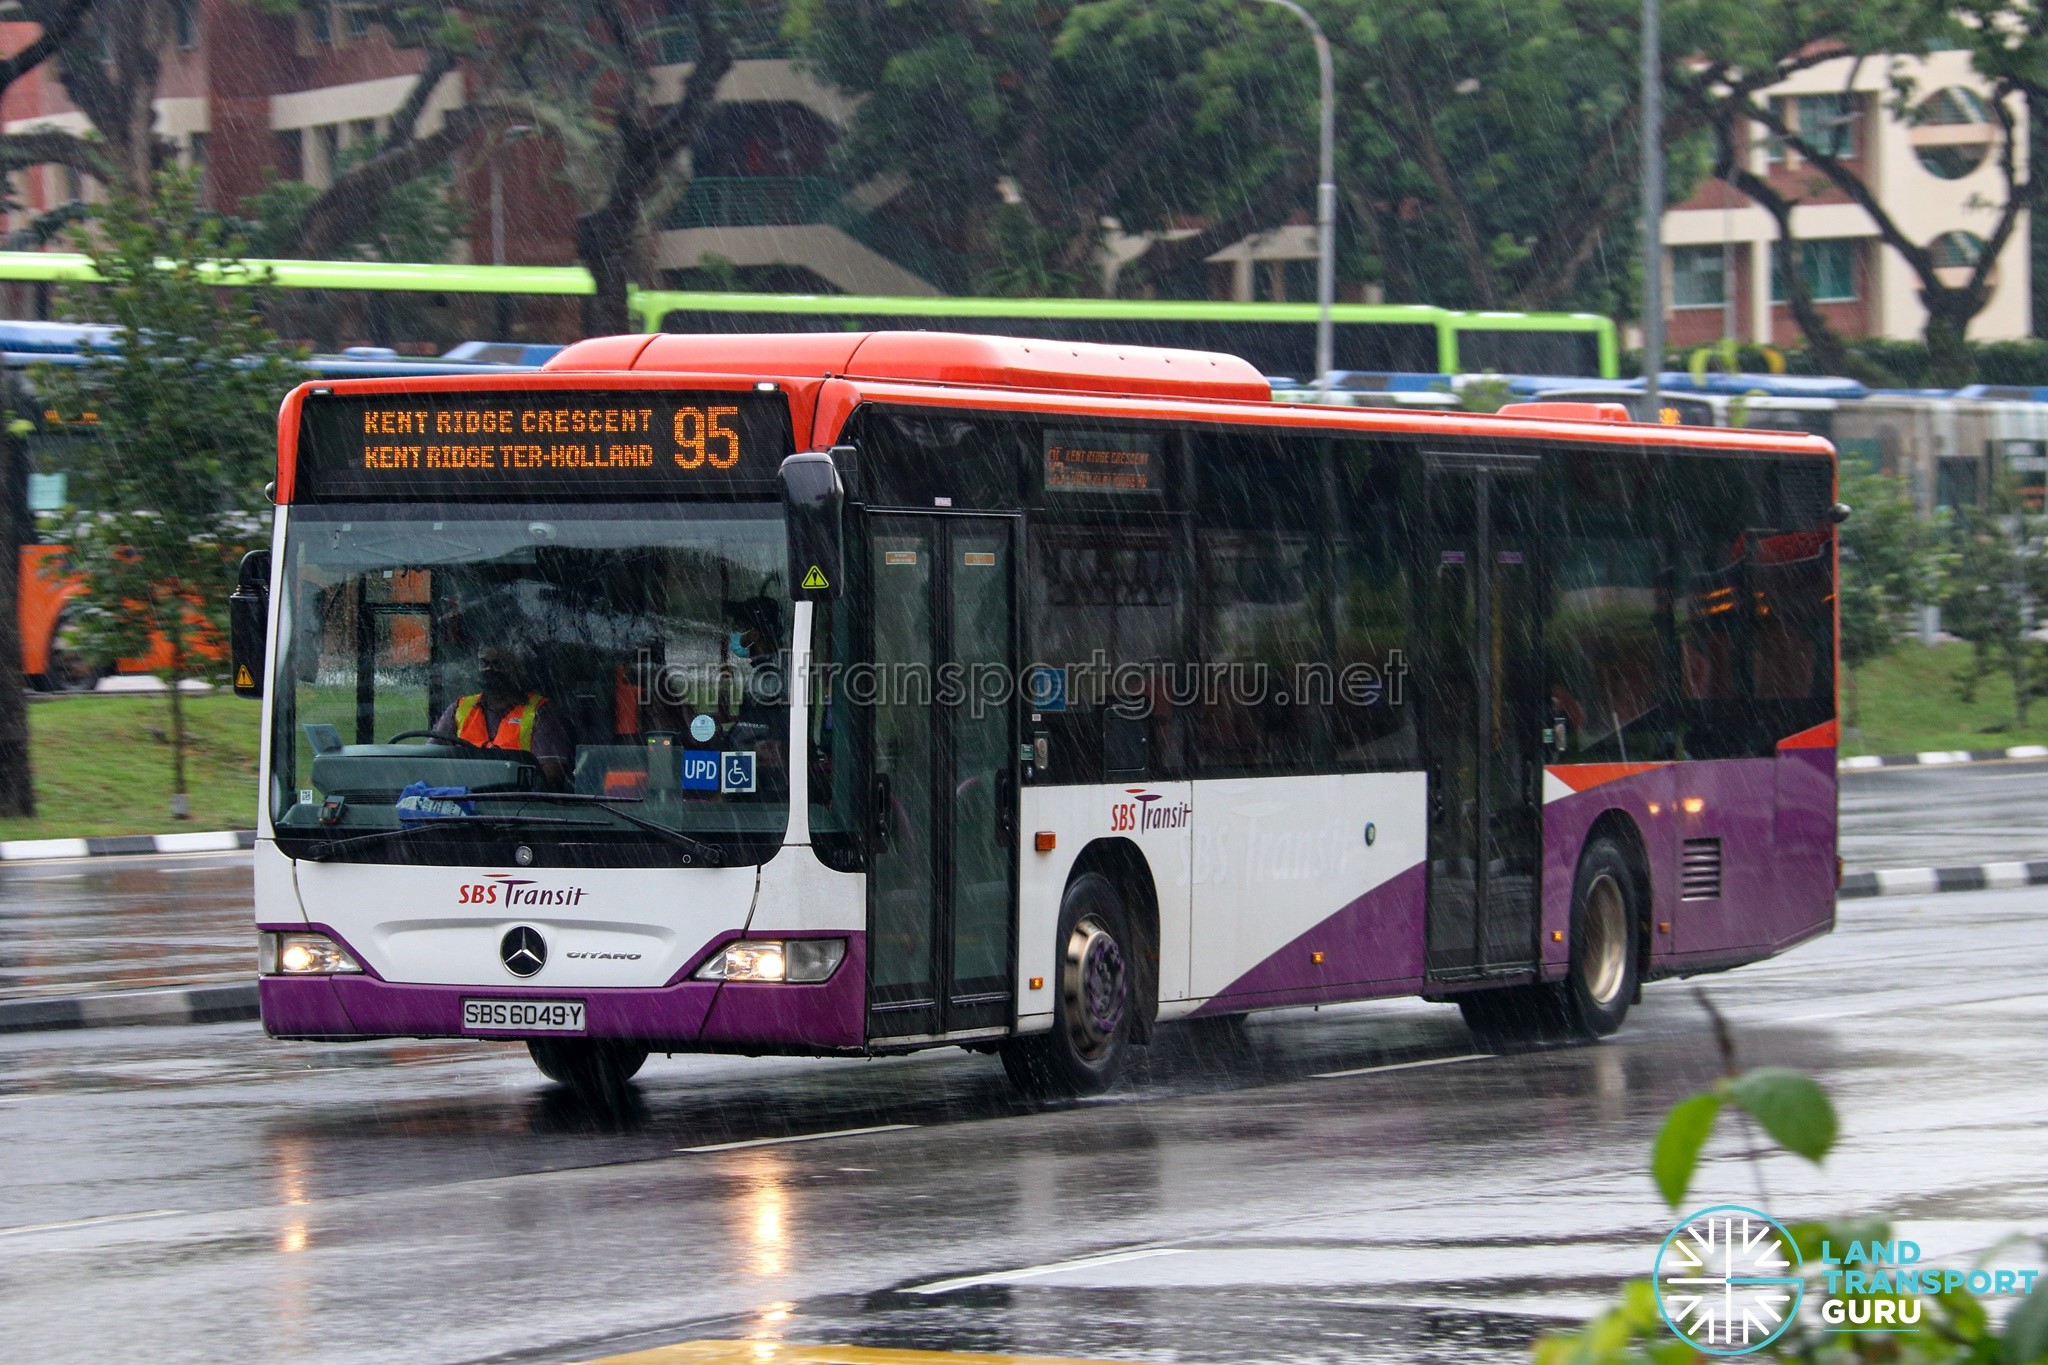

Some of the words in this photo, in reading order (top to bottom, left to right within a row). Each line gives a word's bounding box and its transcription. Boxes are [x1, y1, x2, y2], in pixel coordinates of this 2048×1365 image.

[364, 410, 428, 434] KENT
[436, 410, 513, 434] RIDGE
[521, 409, 653, 433] CRESCENT
[673, 406, 740, 469] 95
[364, 445, 421, 468] KENT
[426, 445, 495, 468] RIDGE
[499, 444, 653, 468] TER-HOLLAND
[684, 759, 717, 780] UPD
[1111, 803, 1135, 831] SBS
[1134, 794, 1192, 835] Transit
[458, 884, 495, 904] SBS
[496, 880, 589, 908] Transit
[566, 951, 642, 961] CITARO
